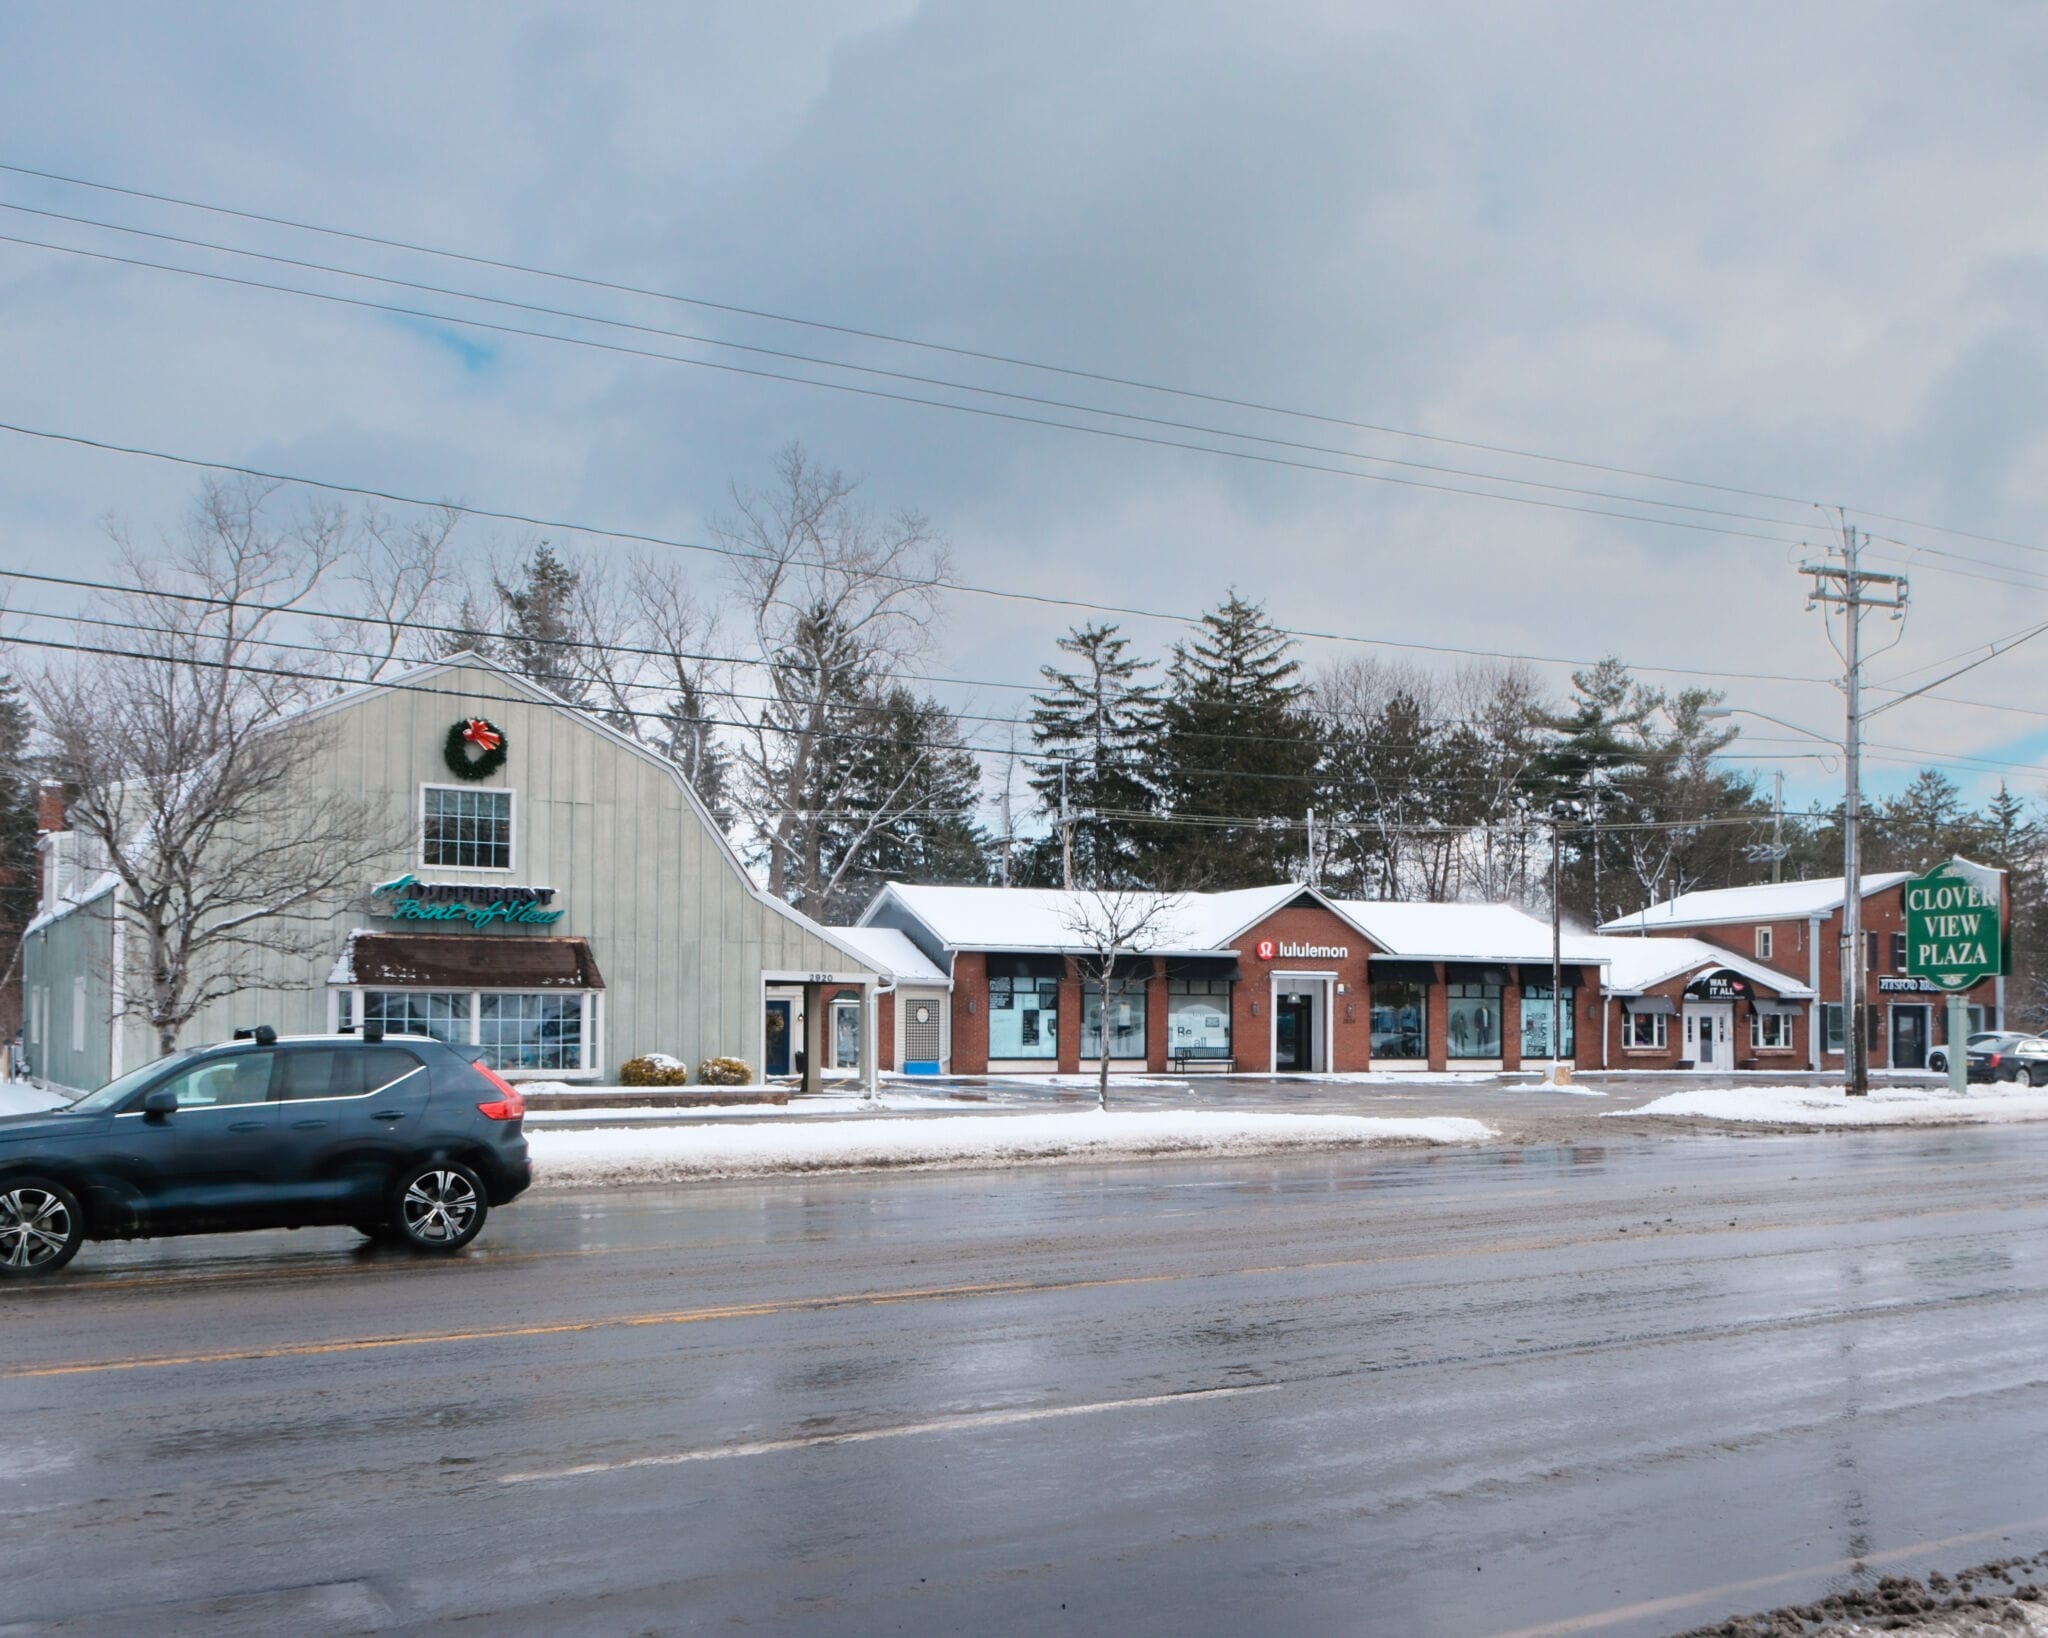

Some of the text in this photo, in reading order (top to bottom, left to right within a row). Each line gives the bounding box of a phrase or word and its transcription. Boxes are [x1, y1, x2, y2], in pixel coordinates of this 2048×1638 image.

[408, 884, 557, 905] DIFFERENT
[1909, 886, 1996, 911] CLOVER
[392, 899, 565, 929] Point of View
[1924, 914, 1981, 938] VIEW
[1280, 942, 1348, 958] lululemon
[1919, 942, 1987, 966] PLAZA
[809, 974, 833, 983] 2920
[1710, 979, 1728, 987] WAX
[1710, 987, 1735, 996] IT ALL
